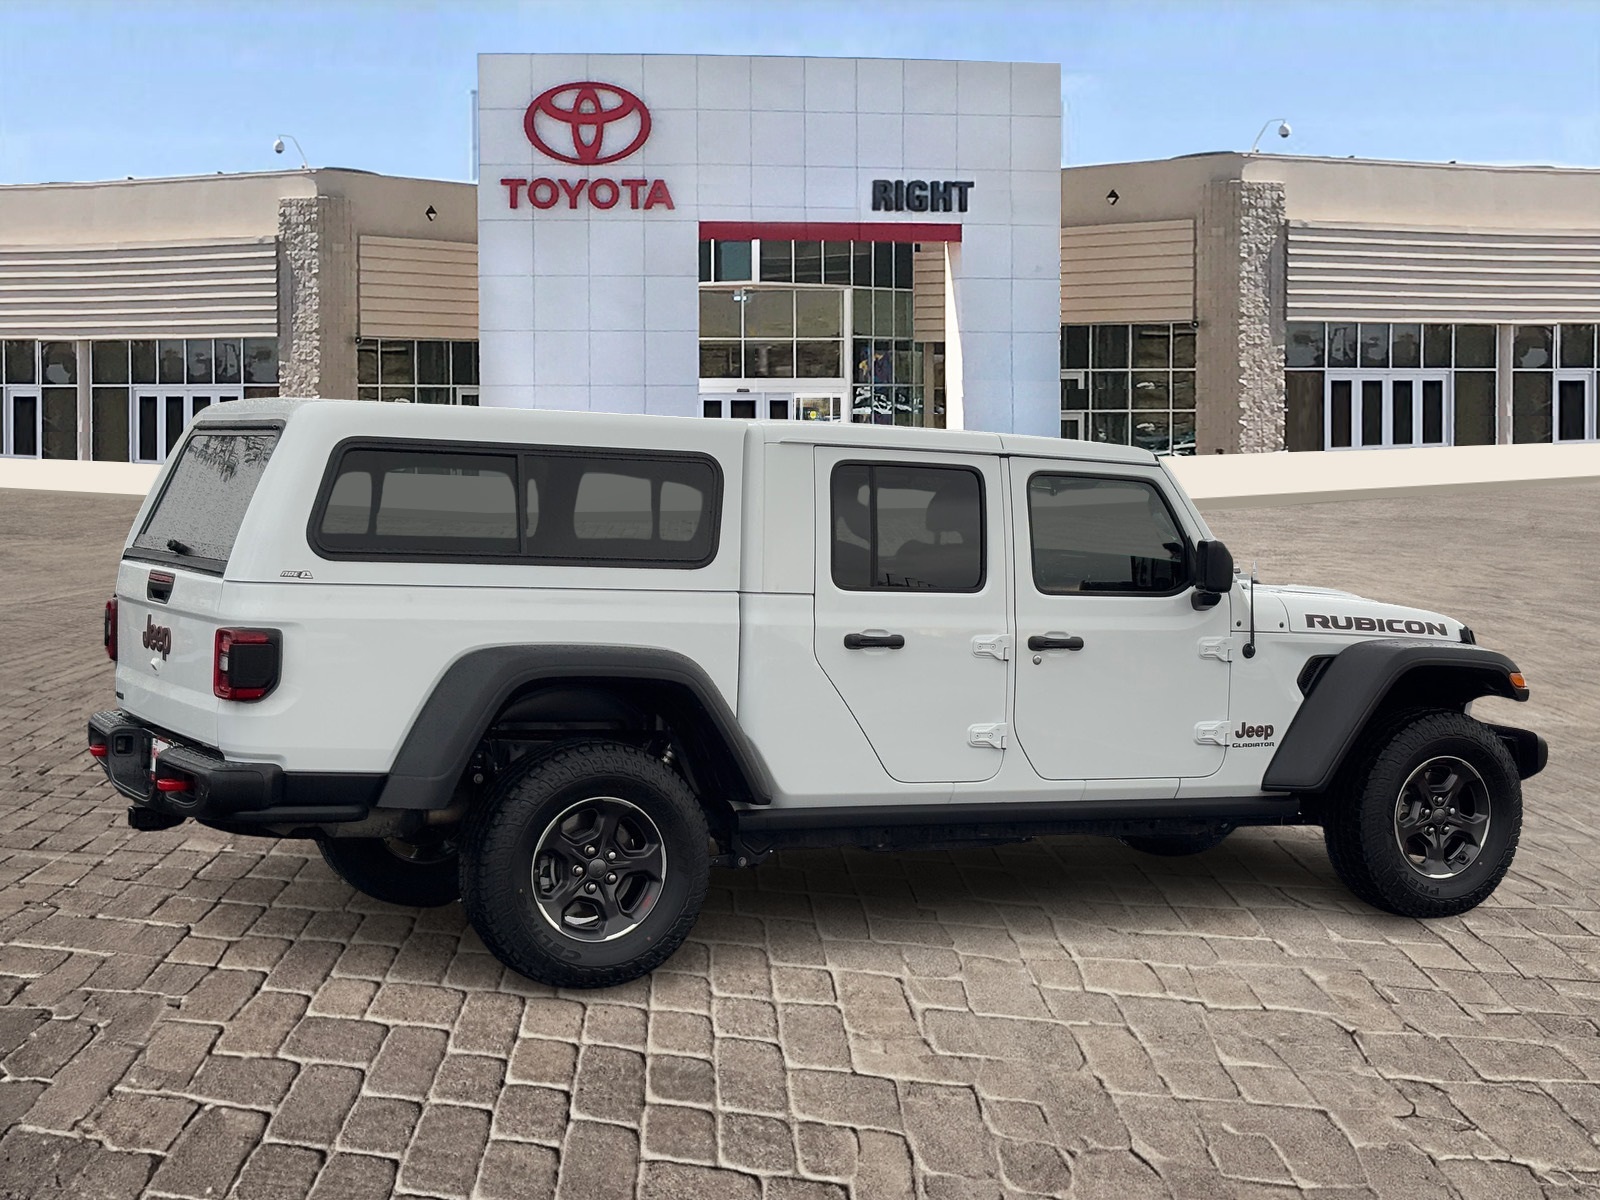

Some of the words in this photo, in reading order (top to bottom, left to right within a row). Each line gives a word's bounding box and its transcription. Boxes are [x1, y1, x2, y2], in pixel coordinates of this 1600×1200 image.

[500, 178, 675, 210] TOYOTA
[872, 180, 974, 212] RIGHT
[143, 614, 171, 661] Jeep
[1305, 614, 1448, 636] RUBICON
[1235, 722, 1274, 740] Jeep
